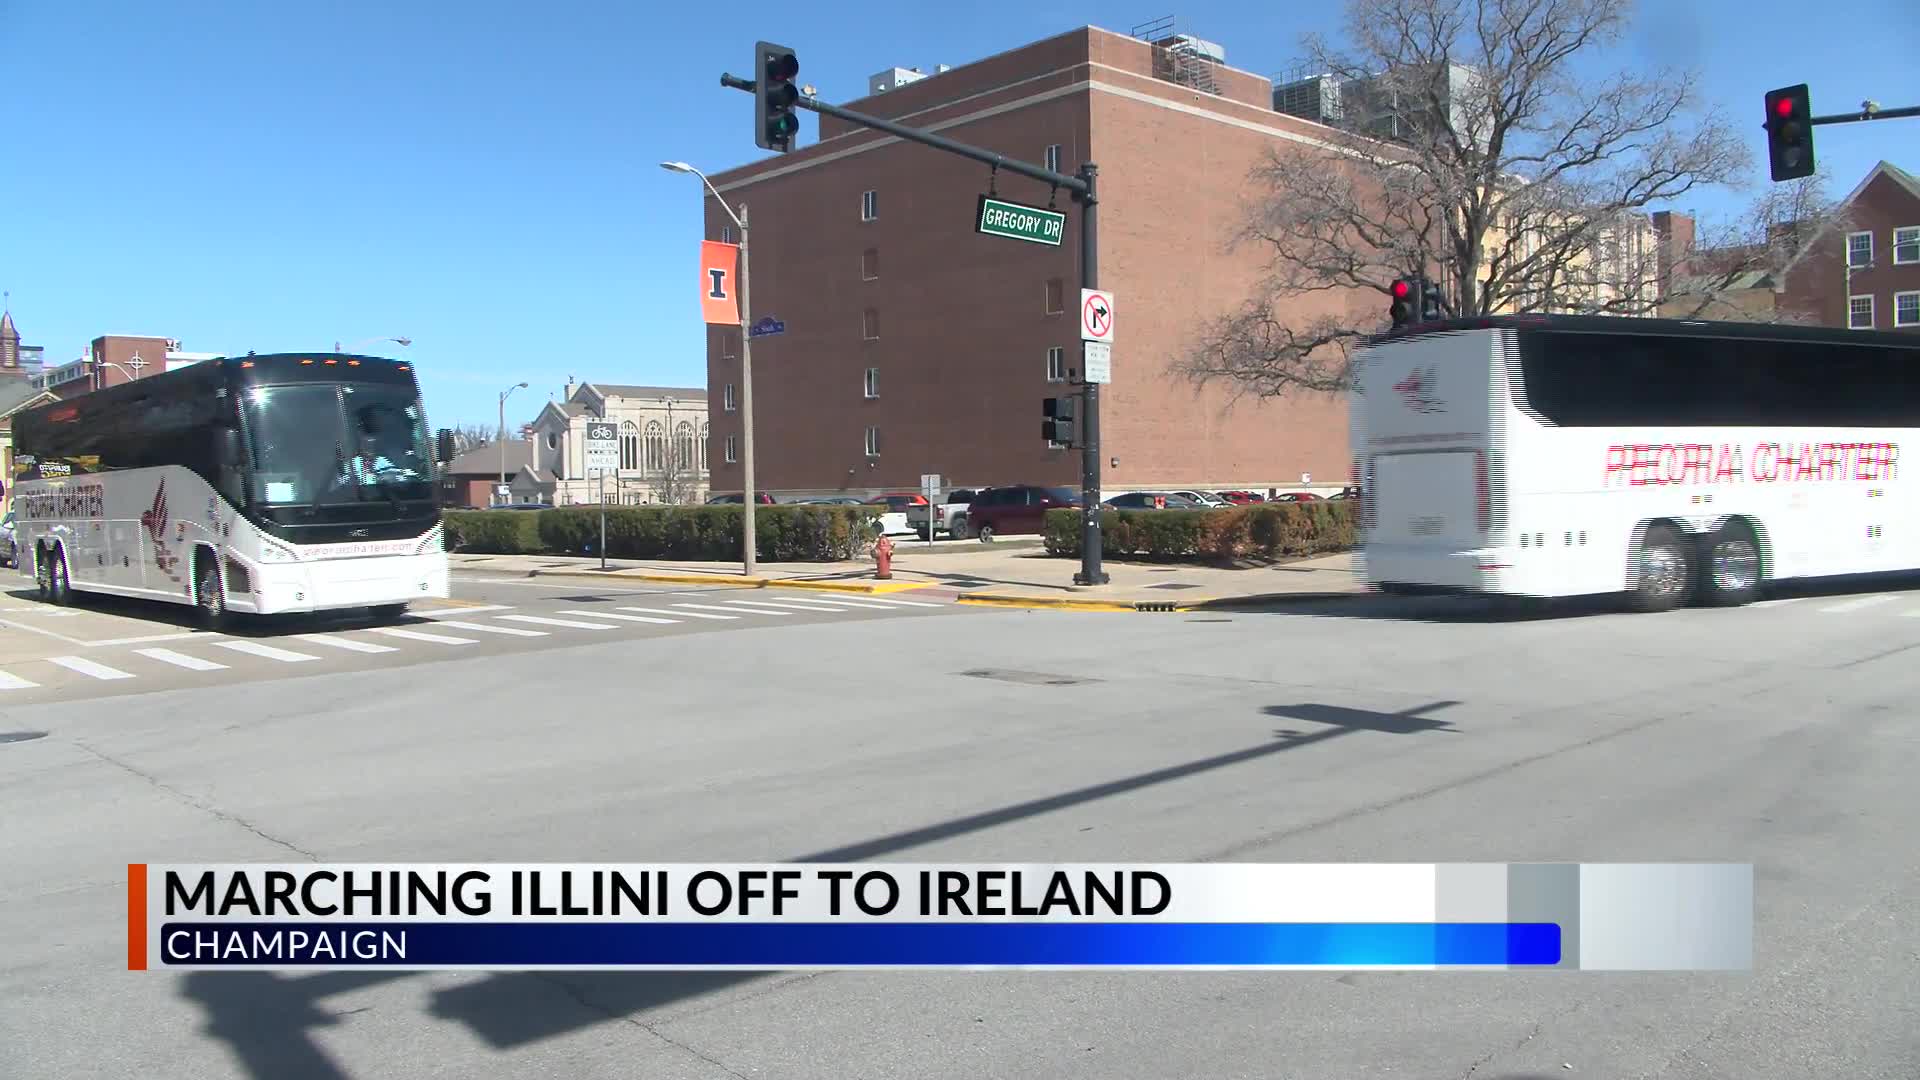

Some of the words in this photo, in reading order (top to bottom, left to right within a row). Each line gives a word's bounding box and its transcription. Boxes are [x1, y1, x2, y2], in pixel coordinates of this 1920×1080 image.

[986, 208, 1041, 233] GREGORY
[1043, 219, 1060, 237] DR
[708, 268, 727, 300] I
[1603, 443, 1744, 487] PEORIA
[1751, 442, 1900, 482] CHARTER
[25, 489, 56, 518] PEORIA
[58, 485, 104, 518] CHARTER
